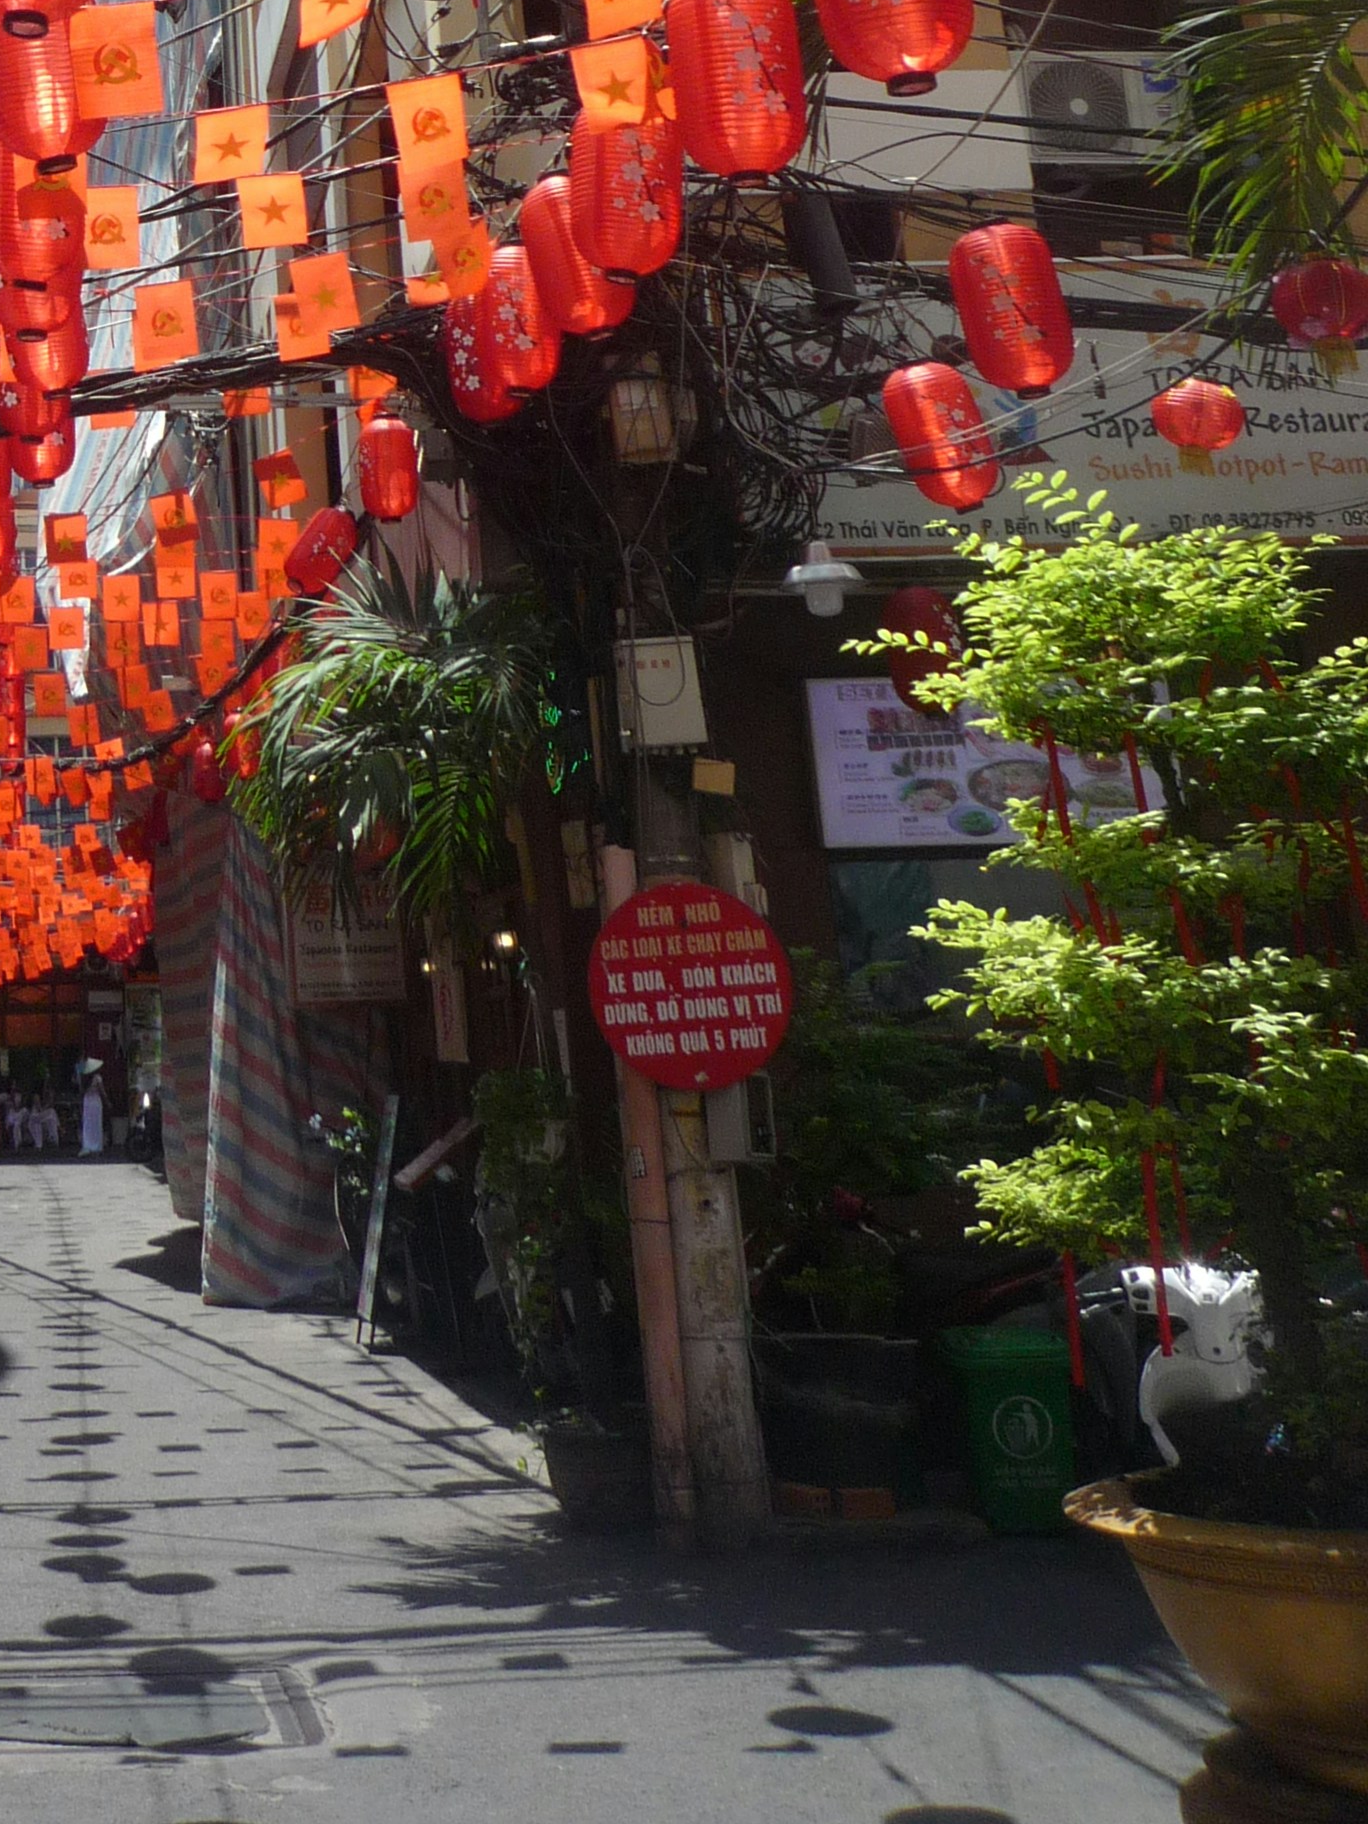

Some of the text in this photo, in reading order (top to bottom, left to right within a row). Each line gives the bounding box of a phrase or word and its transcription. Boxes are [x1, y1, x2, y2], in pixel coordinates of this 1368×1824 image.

[838, 518, 878, 539] Thái
[881, 518, 922, 539] Văn
[684, 894, 722, 926] NHỎ
[601, 935, 630, 961] CÁC
[632, 935, 663, 963] LOẠI
[666, 935, 683, 957] XE
[686, 931, 723, 958] CHẠY
[607, 972, 627, 994] XE
[681, 961, 716, 989] ĐÓN
[721, 958, 777, 987] KHÁCH
[683, 992, 729, 1020] ĐÚNG
[732, 994, 752, 1022] VỊ
[754, 987, 783, 1015] TRÍ
[625, 1022, 768, 1057] KHÔNG QUÁ 5 PHÚT
